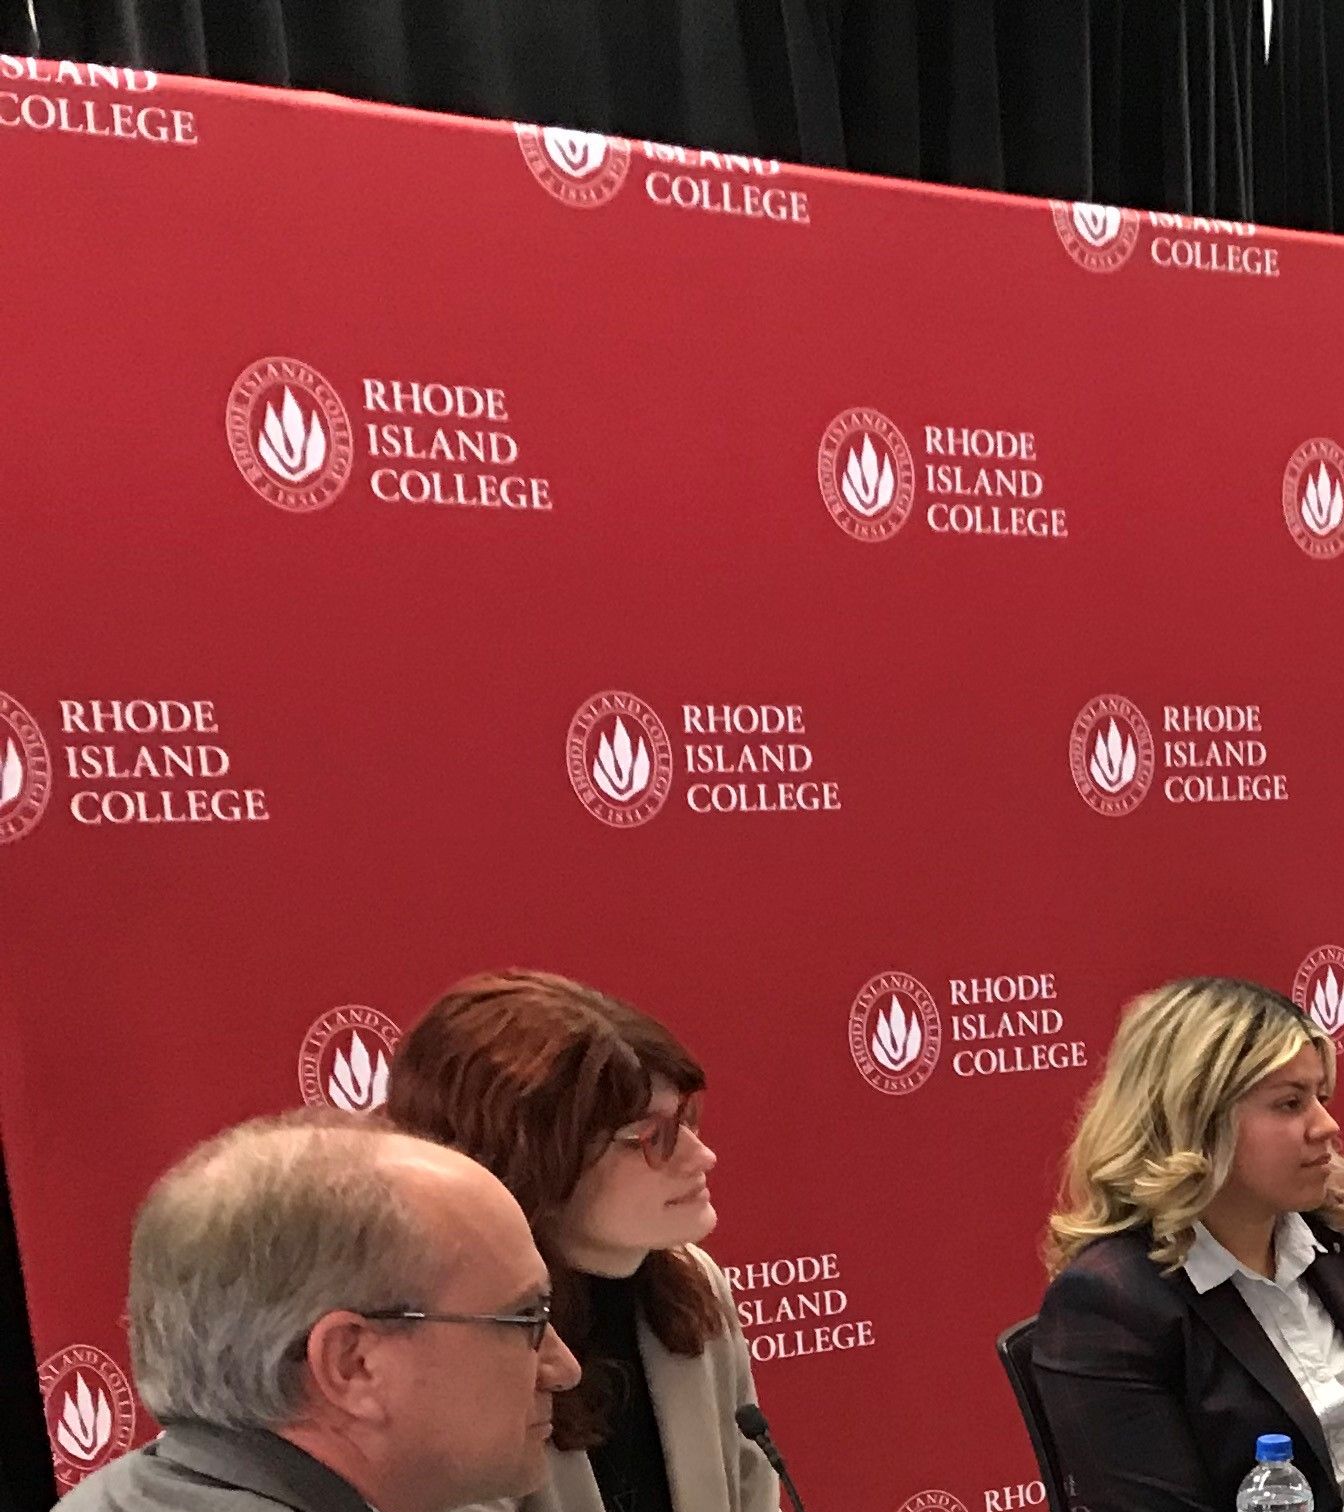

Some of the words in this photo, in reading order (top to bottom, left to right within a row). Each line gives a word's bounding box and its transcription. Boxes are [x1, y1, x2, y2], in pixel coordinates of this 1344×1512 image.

[0, 54, 157, 92] SLAND
[0, 91, 199, 144] COLLEGE
[645, 171, 811, 225] COLLEGE
[1150, 236, 1281, 276] COLLEGE
[243, 361, 316, 399] ISLAND
[362, 379, 509, 423] RHODE
[367, 423, 518, 464] ISLAND
[924, 425, 1037, 461] RHODE
[370, 469, 554, 511] COLLEGE
[925, 463, 1044, 499] ISLAND
[926, 503, 1069, 538] COLLEGE
[59, 699, 219, 733] RHODE
[577, 694, 641, 729] ISLAND
[682, 704, 805, 734] RHODE
[1163, 705, 1262, 732] RHODE
[64, 744, 231, 779] ISLAND
[686, 744, 813, 773] ISLAND
[1164, 740, 1267, 768] ISLAND
[69, 788, 271, 825] COLLEGE
[686, 782, 842, 813] COLLEGE
[1164, 774, 1289, 803] COLLEGE
[858, 975, 917, 1009] ISLAND
[949, 972, 1057, 1006] RHODE
[309, 1007, 379, 1048] ISLAND
[951, 1008, 1064, 1042] ISLAND
[953, 1040, 1088, 1077] COLLEGE
[724, 1253, 840, 1291] RHODE
[737, 1289, 848, 1328] SLAND
[750, 1320, 876, 1362] OLLEGE
